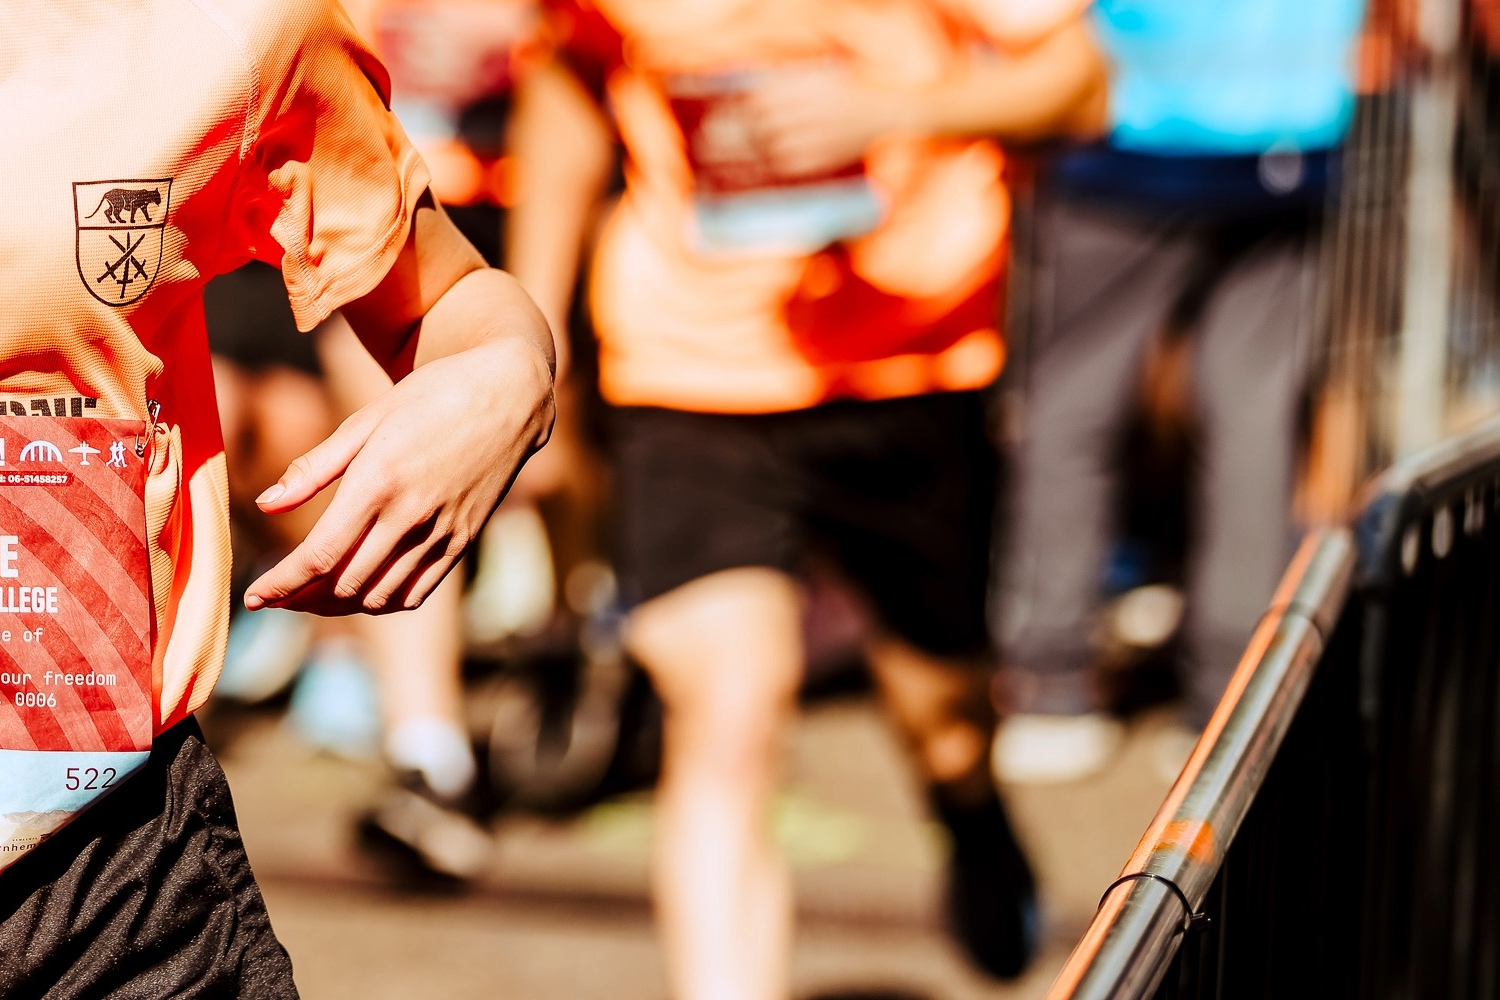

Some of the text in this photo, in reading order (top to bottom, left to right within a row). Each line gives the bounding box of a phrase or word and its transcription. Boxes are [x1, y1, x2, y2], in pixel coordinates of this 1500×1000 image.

[7, 474, 68, 484] 06-51458257
[22, 627, 44, 642] of
[1, 672, 32, 685] our
[43, 670, 117, 686] freedom
[15, 691, 57, 708] 0006
[65, 767, 117, 791] 522
